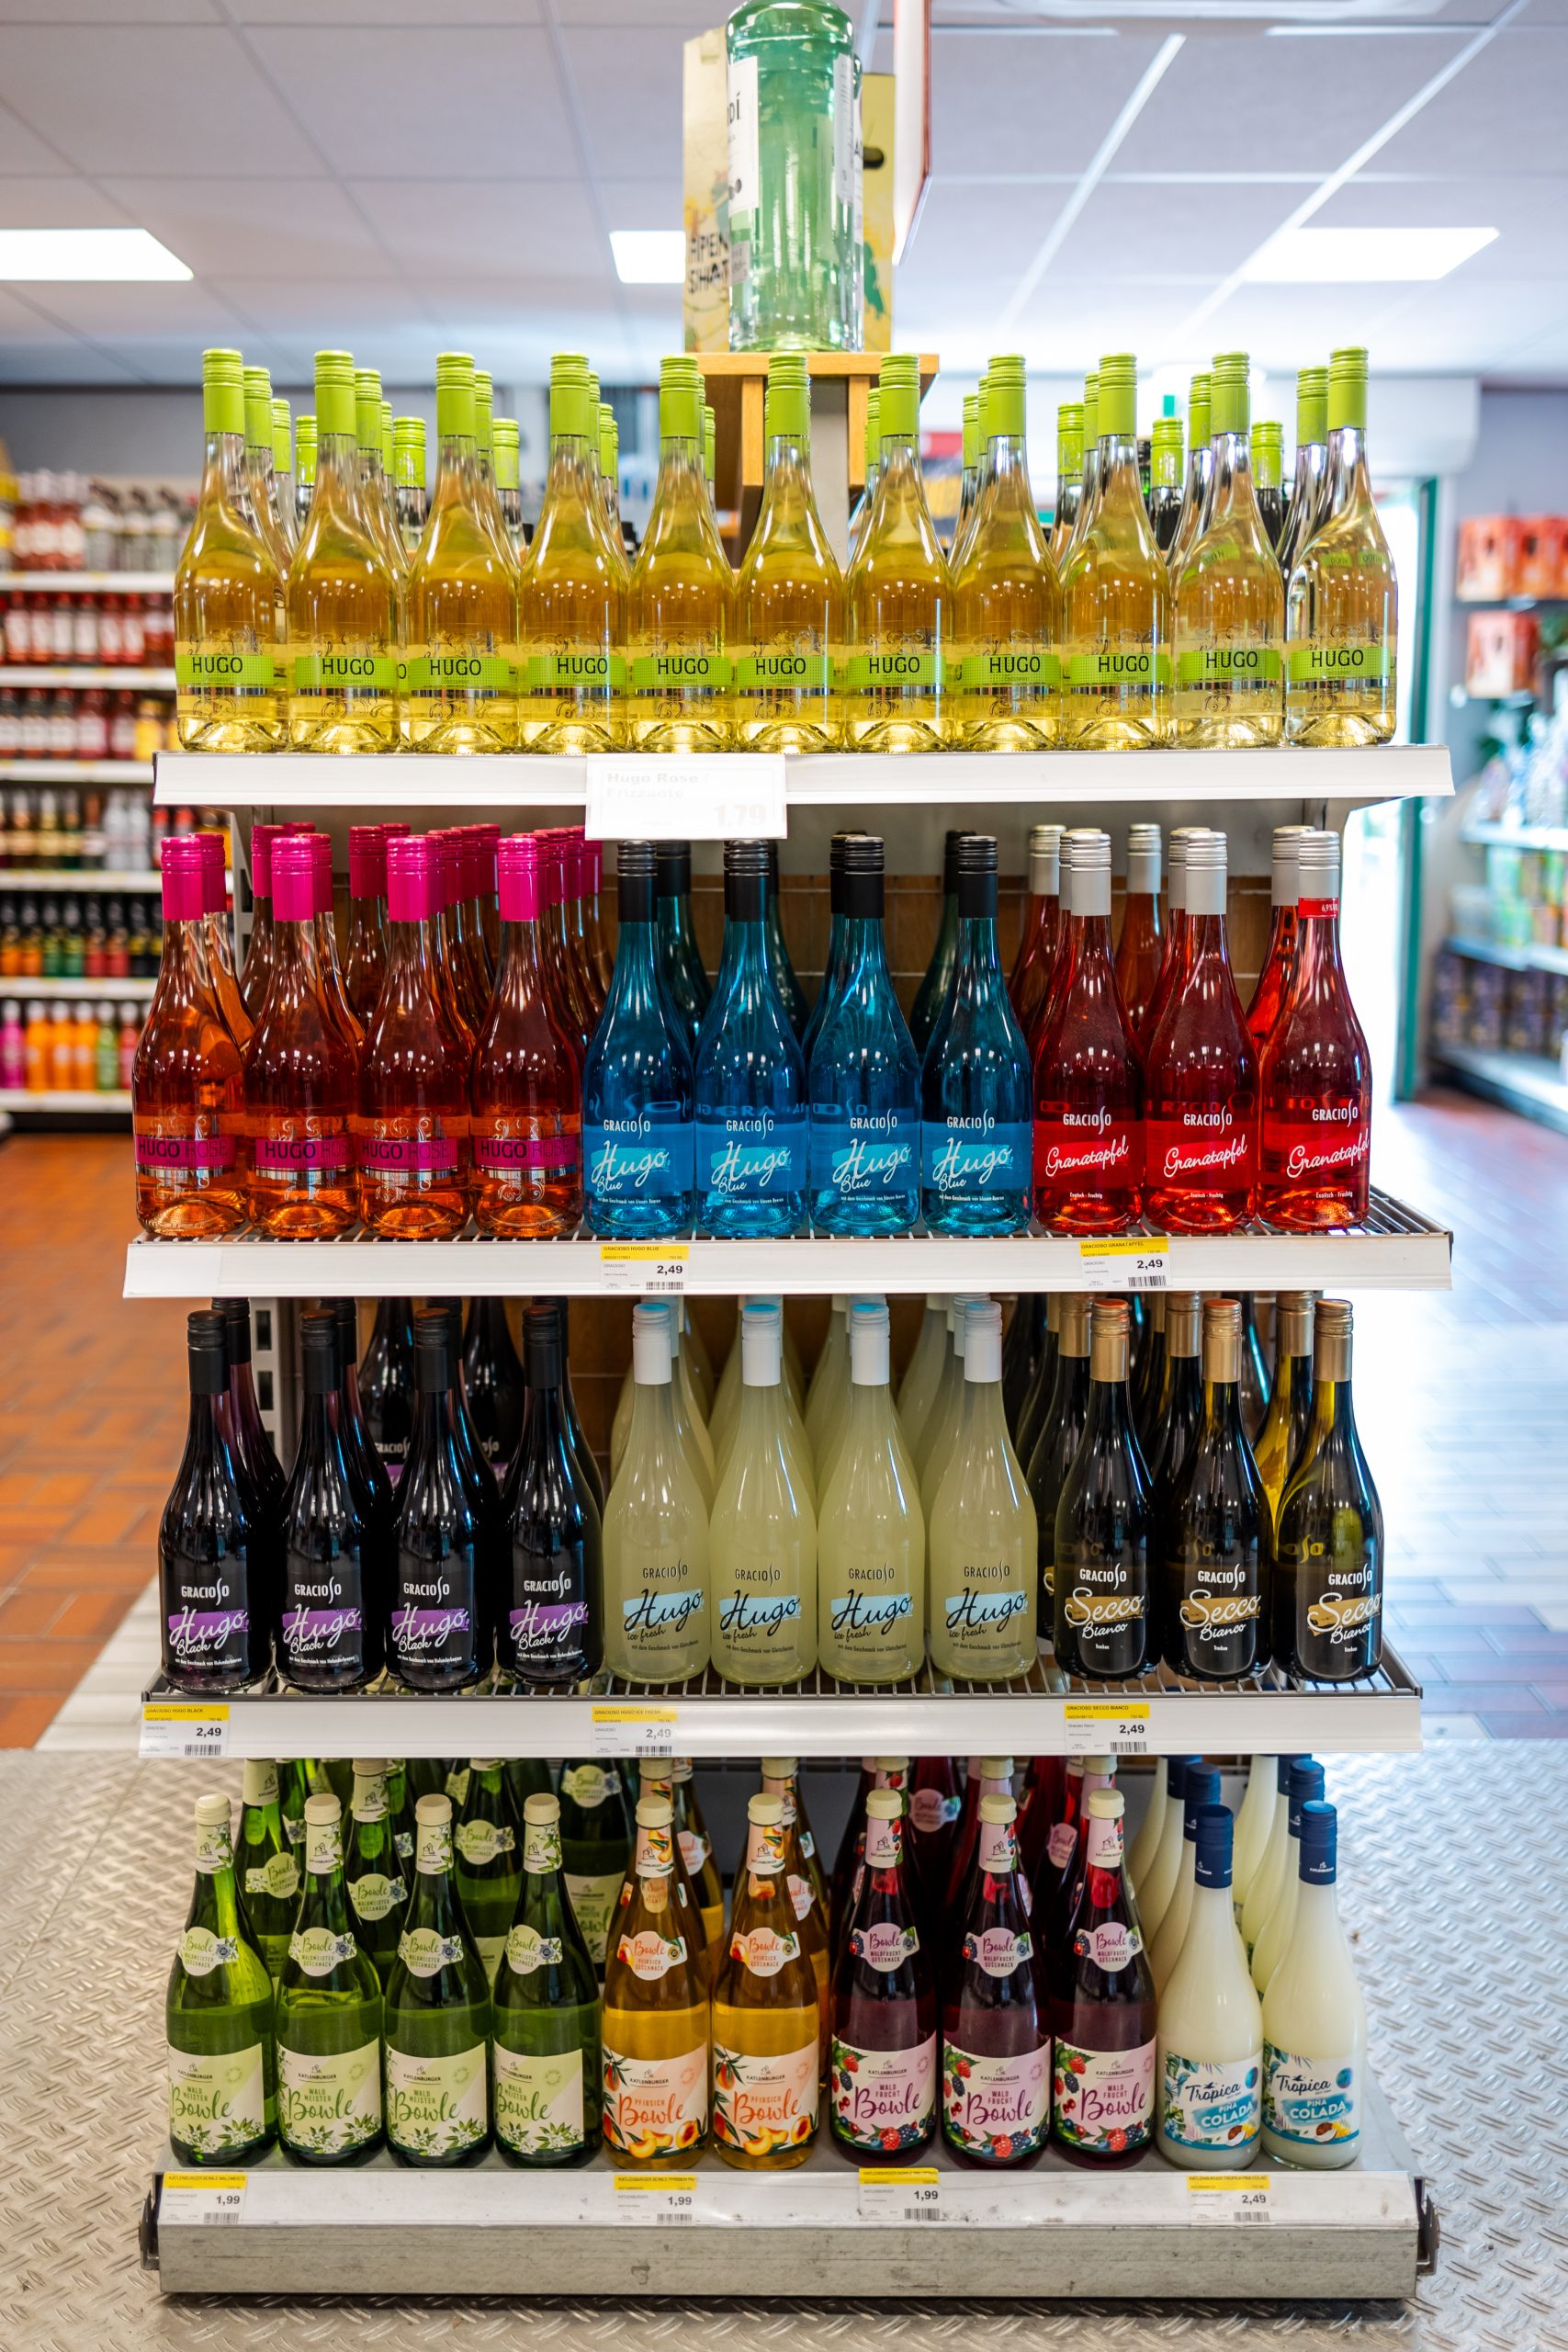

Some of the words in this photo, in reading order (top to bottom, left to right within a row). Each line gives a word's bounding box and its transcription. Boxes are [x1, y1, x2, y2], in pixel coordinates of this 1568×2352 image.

[191, 656, 243, 674] HUGO
[321, 657, 375, 676] HUGO
[430, 658, 482, 676] HUGO
[557, 657, 608, 675] HUGO
[658, 657, 709, 675] HUGO
[755, 657, 807, 675] HUGO
[869, 656, 920, 674] HUGO
[989, 655, 1041, 673] HUGO
[1098, 655, 1149, 673] HUGO
[1205, 650, 1258, 669] HUGO
[1312, 649, 1364, 668] HUGO
[607, 773, 651, 786] Hugo
[657, 773, 698, 784] Rose
[850, 1108, 897, 1137] GRACIOSO
[946, 1108, 995, 1137] GRACIOSO
[1063, 1105, 1111, 1135] GRACIOSO
[1183, 1105, 1233, 1134] GRACIOSO
[1312, 1099, 1359, 1128] GRACIOSO
[604, 1112, 651, 1141] GRACIOSO
[726, 1112, 774, 1140] GRACIOSO
[139, 1138, 180, 1159] HUGO
[185, 1137, 228, 1159] ROSE
[265, 1142, 316, 1159] HUGO
[362, 1141, 403, 1160] HUGO
[408, 1142, 448, 1159] ROSE
[480, 1139, 527, 1159] HUGO
[532, 1137, 571, 1159] ROSE
[1045, 1135, 1129, 1177] Granatapfel
[1163, 1134, 1247, 1178] Granatapfel
[1286, 1127, 1370, 1179] Granatapfel
[592, 1139, 669, 1188] Hugo
[711, 1139, 791, 1187] Hugo
[832, 1137, 912, 1184] Hugo
[932, 1136, 1012, 1184] Hugo
[597, 1176, 623, 1194] Blue
[718, 1176, 748, 1194] Blue
[840, 1174, 872, 1193] Blue
[939, 1173, 967, 1192] Blue
[657, 1265, 683, 1275] 2,49
[1136, 1259, 1163, 1270] 2,49
[642, 1557, 688, 1584] GRACIOSO
[735, 1563, 781, 1588] GRACIOSO
[849, 1560, 895, 1589] GRACIOSO
[964, 1557, 1010, 1586] GRACIOSO
[1079, 1562, 1127, 1590] GRACIOSO
[1197, 1563, 1246, 1591] GRACIOSO
[1328, 1563, 1373, 1591] GRACIOSO
[181, 1577, 230, 1606] GRACIOSO
[294, 1576, 342, 1604] GRACIOSO
[403, 1576, 450, 1604] GRACIOSO
[524, 1570, 572, 1599] GRACIOSO
[624, 1588, 705, 1633] Hugo
[719, 1589, 801, 1637] Hugo
[831, 1588, 913, 1635] Hugo
[945, 1587, 1028, 1634] Hugo
[1064, 1587, 1145, 1626] Secco
[1179, 1589, 1261, 1628] Secco
[1307, 1592, 1382, 1633] Secco
[169, 1605, 248, 1650] Hugo
[283, 1603, 361, 1648] Hugo
[391, 1601, 468, 1647] Hugo
[511, 1599, 588, 1643] Hugo
[1081, 1621, 1128, 1639] Bianco
[518, 1632, 555, 1650] Black
[639, 1625, 667, 1643] fresh
[733, 1626, 758, 1644] fresh
[845, 1625, 873, 1643] fresh
[960, 1624, 988, 1641] fresh
[1200, 1623, 1247, 1641] Bianco
[1330, 1623, 1372, 1644] Bianco
[176, 1638, 212, 1657] Black
[289, 1635, 324, 1655] Black
[398, 1634, 433, 1653] Black
[196, 1727, 222, 1738] 2,49
[646, 1728, 671, 1739] 2,49
[1119, 1724, 1145, 1736] 2,49
[302, 1936, 333, 1953] Bowle
[411, 1938, 439, 1952] Bowle
[634, 1939, 666, 1957] Bowle
[749, 1937, 780, 1955] Bowle
[869, 1933, 901, 1949] Bowle
[983, 1937, 1014, 1954] Bowle
[1096, 1932, 1127, 1949] Bowle
[186, 2086, 203, 2094] WALD
[413, 2089, 431, 2098] WALD
[508, 2084, 523, 2093] WALD
[1103, 2090, 1127, 2098] FRUCHT
[1185, 2081, 1241, 2103] Tropica
[1275, 2075, 1332, 2097] Tropica
[172, 2083, 234, 2120] Bowle
[288, 2087, 356, 2121] Bowle
[394, 2087, 459, 2122] Bowle
[496, 2082, 552, 2121] Bowle
[618, 2092, 686, 2127] Bowle
[733, 2087, 801, 2124] Bowle
[854, 2082, 922, 2119] Bowle
[967, 2089, 1034, 2125] Bowle
[1080, 2082, 1145, 2120] Bowle
[1289, 2100, 1348, 2120] COLADA
[1201, 2100, 1253, 2128] COLADA
[216, 2195, 241, 2206] 1,99
[668, 2196, 693, 2207] 1,99
[913, 2190, 939, 2201] 1,99
[1241, 2194, 1267, 2205] 2,49
